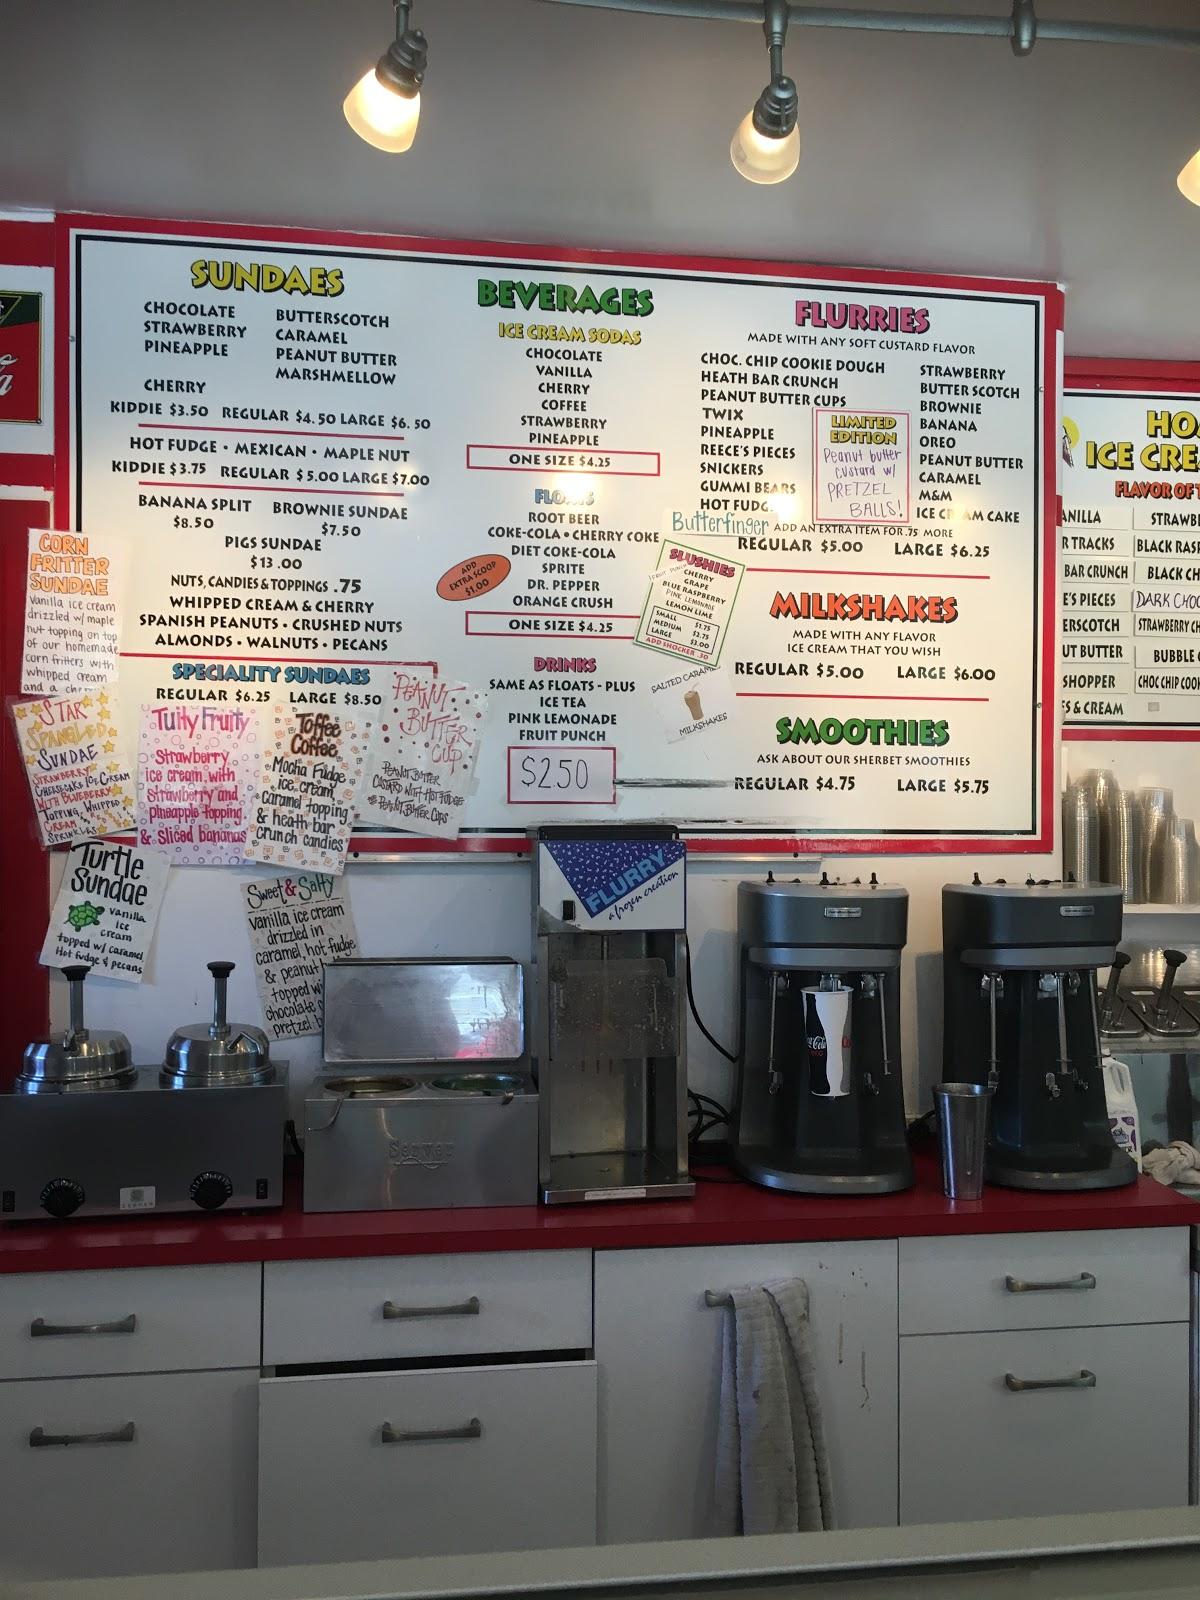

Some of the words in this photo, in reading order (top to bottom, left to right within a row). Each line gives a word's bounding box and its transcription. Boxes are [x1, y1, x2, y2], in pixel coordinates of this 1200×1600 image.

[191, 259, 345, 297] SUNDAES
[478, 279, 654, 317] BEVERAGES
[144, 301, 235, 318] CHOCOLATE
[795, 300, 930, 334] FLURRIES
[277, 309, 389, 328] BUTTERSCOTCH
[144, 320, 246, 338] STRAWBERRY
[276, 329, 347, 344] CARAMEL
[499, 322, 523, 338] ICE
[527, 324, 585, 342] CREAM
[588, 328, 641, 345] SODAS
[145, 340, 228, 356] PINEAPPLE
[748, 333, 782, 343] MADE
[786, 335, 816, 345] WITH
[821, 337, 846, 346] ANY
[850, 339, 876, 348] SOFT
[879, 340, 929, 351] CUSTARD
[933, 343, 975, 354] FLAVOR
[277, 348, 337, 362] PEANUT
[342, 352, 397, 366] BUTTER
[526, 348, 602, 362] CHOCOLATE
[701, 353, 741, 365] CHOC.
[746, 355, 778, 367] CHIP
[782, 357, 832, 370] COOKIE
[837, 360, 884, 373] DOUGH
[276, 367, 396, 384] MARSHMELLOW
[536, 365, 592, 378] VANILLA
[702, 371, 747, 384] HEATH
[753, 373, 779, 386] BAR
[783, 375, 838, 389] CRUNCH
[920, 365, 1005, 380] STRAWBERRY
[144, 379, 206, 393] CHERRY
[538, 383, 589, 394] CHERRY
[111, 401, 162, 414] KIDDIE
[170, 403, 208, 416] $3.50
[542, 400, 586, 411] COFFEE
[921, 400, 981, 414] BROWNIE
[521, 415, 607, 429] STRAWBERRY
[702, 408, 743, 421] TWIX
[831, 415, 897, 430] LIMITED
[701, 426, 774, 440] PINEAPPLE
[921, 418, 977, 432] BANANA
[530, 432, 598, 446] PINEAPPLE
[830, 431, 897, 445] EDITION
[920, 436, 956, 448] OREO
[130, 437, 164, 450] HOT
[168, 439, 216, 453] FUDGE
[235, 442, 306, 457] MEXICAN
[324, 447, 374, 460] MAPLE
[379, 450, 410, 462] NUT
[1086, 441, 1133, 470] ICE
[509, 454, 540, 465] ONE
[545, 455, 574, 465] SIZE
[580, 456, 610, 467] $4.25
[700, 462, 763, 475] SNICKERS
[919, 472, 981, 485] CARAMEL
[828, 483, 891, 502] PRETZEL
[1115, 480, 1172, 499] FLAVOR
[139, 495, 207, 509] BANANA
[212, 499, 251, 512] SPLIT
[273, 502, 344, 517] BROWNIE
[349, 506, 407, 520] SUNDAE
[850, 503, 903, 518] BALLS!
[174, 515, 214, 528] $8.50
[529, 512, 565, 523] ROOT
[569, 514, 599, 525] BEER
[672, 511, 769, 535] Butterfinger
[322, 522, 361, 536] $7.50
[39, 533, 89, 555] CORN
[226, 536, 257, 548] PIGS
[262, 538, 321, 551] SUNDAE
[1072, 536, 1115, 551] TRACKS
[30, 553, 110, 576] FRITTER
[461, 561, 477, 575] ADD
[542, 563, 584, 574] SPRITE
[669, 548, 735, 578] SLUSHIES
[449, 574, 474, 591] EXTRA
[473, 561, 496, 579] SCOOP
[684, 569, 714, 583] CHERRY
[1064, 565, 1085, 578] BAR
[1087, 565, 1128, 579] CRUNCH
[29, 573, 109, 596] SUNDAE
[465, 578, 489, 596] $1.00
[528, 579, 548, 590] DR.
[553, 580, 599, 591] PEPPER
[662, 580, 680, 591] BLUE
[682, 586, 726, 605] RASPBERRY
[684, 578, 709, 591] GRAPE
[170, 596, 241, 609] WHIPPED
[246, 599, 298, 611] CREAM
[302, 600, 311, 611] &
[315, 601, 374, 613] CHERRY
[513, 595, 567, 607] ORANGE
[571, 597, 612, 608] CRUSH
[770, 591, 958, 623] MILKSHAKES
[1137, 592, 1170, 609] DARK
[666, 600, 693, 614] LEMON
[695, 607, 713, 619] LIME
[140, 614, 204, 627] SPANISH
[211, 616, 278, 629] PEANUTS
[293, 619, 360, 631] CRUSHED
[365, 621, 402, 632] NUTS
[656, 610, 677, 621] SMALL
[694, 622, 710, 632] $1.75
[651, 627, 672, 638] LARGE
[653, 619, 682, 632] MEDIUM
[692, 630, 709, 641] $2.75
[155, 634, 232, 647] ALMONDS
[247, 637, 318, 649] WALNUTS
[333, 638, 387, 651] PECANS
[534, 657, 596, 673] DRINKS
[172, 663, 281, 681] SPECIALITY
[285, 665, 370, 685] SUNDAES
[393, 674, 466, 712] PEANUT
[651, 676, 682, 694] SALTED
[157, 688, 227, 701] REGULAR
[236, 689, 270, 702] $6.25
[290, 692, 336, 704] LARGE
[345, 692, 381, 705] $8.50
[1083, 703, 1124, 715] CREAM
[295, 713, 342, 737] Toffee
[400, 708, 472, 746] BUTTER
[509, 713, 540, 724] PINK
[545, 713, 616, 725] LEMONADE
[679, 712, 728, 736] MILKSHAKES
[520, 730, 557, 740] FRUIT
[561, 730, 605, 741] PUNCH
[776, 716, 950, 747] SMOOTHIES
[291, 734, 338, 758] Coffee
[272, 756, 307, 776] Mocha
[313, 762, 346, 788] Fudge
[735, 777, 808, 790] REGULAR
[817, 776, 855, 791] $4.75
[898, 779, 945, 792] LARGE
[955, 779, 988, 794] $5.75
[70, 841, 144, 879] Turtle
[71, 867, 147, 905] Sundae
[586, 848, 666, 913] FLURRY
[247, 880, 287, 909] Sweet
[285, 879, 296, 896] &
[299, 875, 334, 900] Salty
[615, 896, 642, 919] frozen
[644, 871, 678, 897] creation
[110, 907, 146, 923] vanilla
[116, 921, 129, 930] ice
[101, 930, 132, 941] cream
[268, 924, 308, 945] drizzled
[266, 999, 316, 1021] chocolate
[273, 1016, 311, 1037] pretzel
